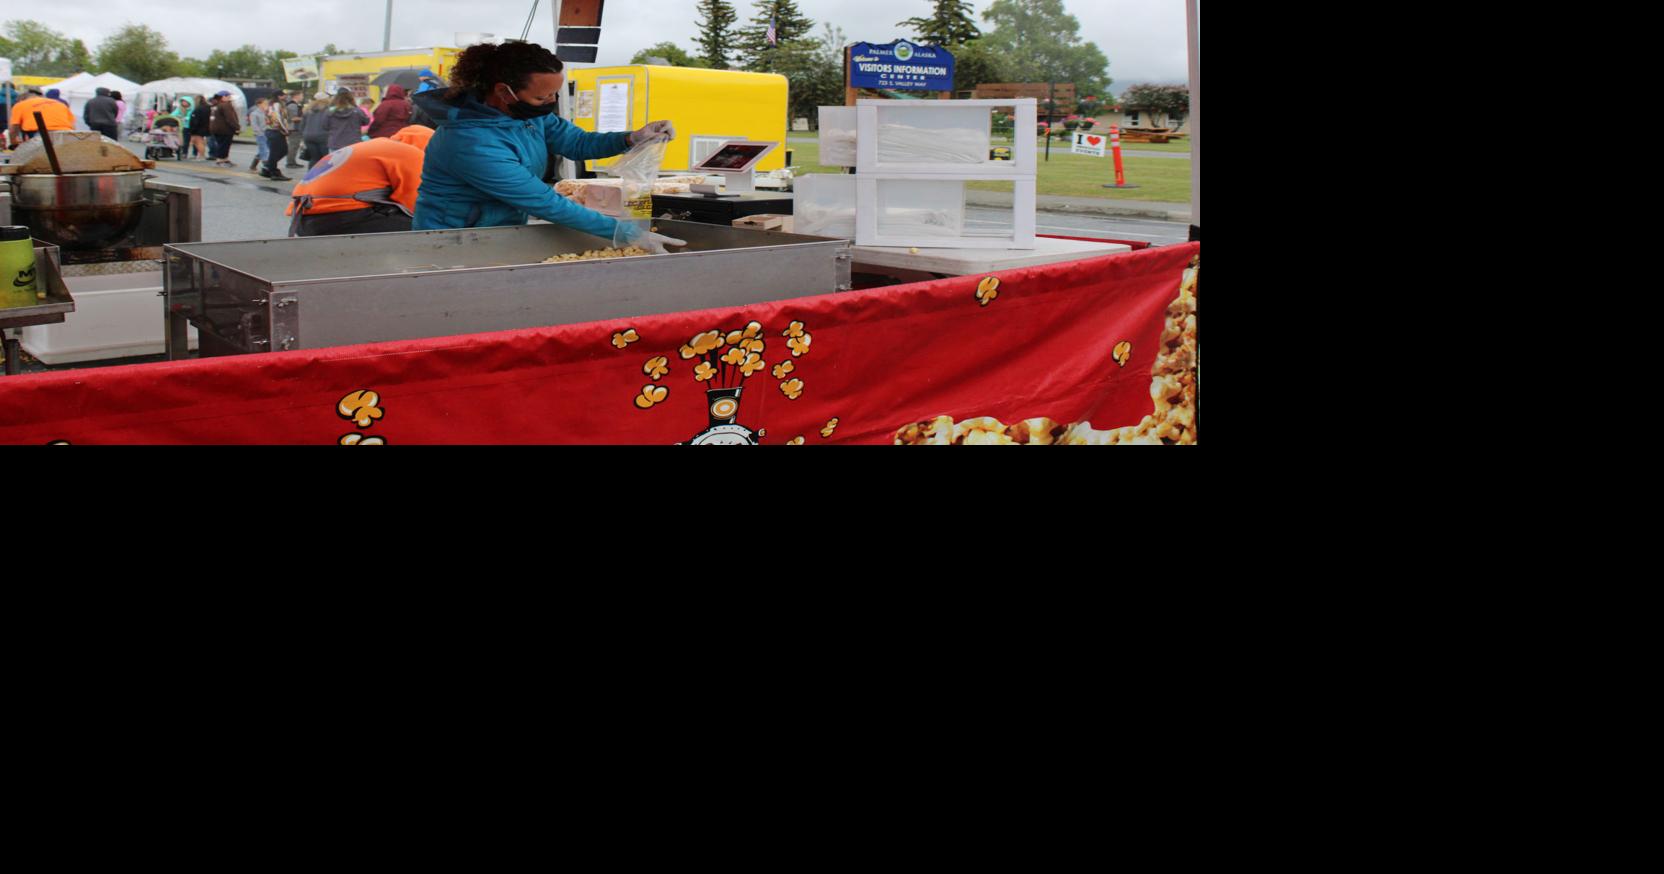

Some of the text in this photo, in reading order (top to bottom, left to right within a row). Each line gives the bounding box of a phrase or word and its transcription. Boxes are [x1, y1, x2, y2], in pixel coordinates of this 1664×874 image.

[859, 63, 947, 75] VISITORS INFORMATION
[1077, 134, 1083, 144] I
